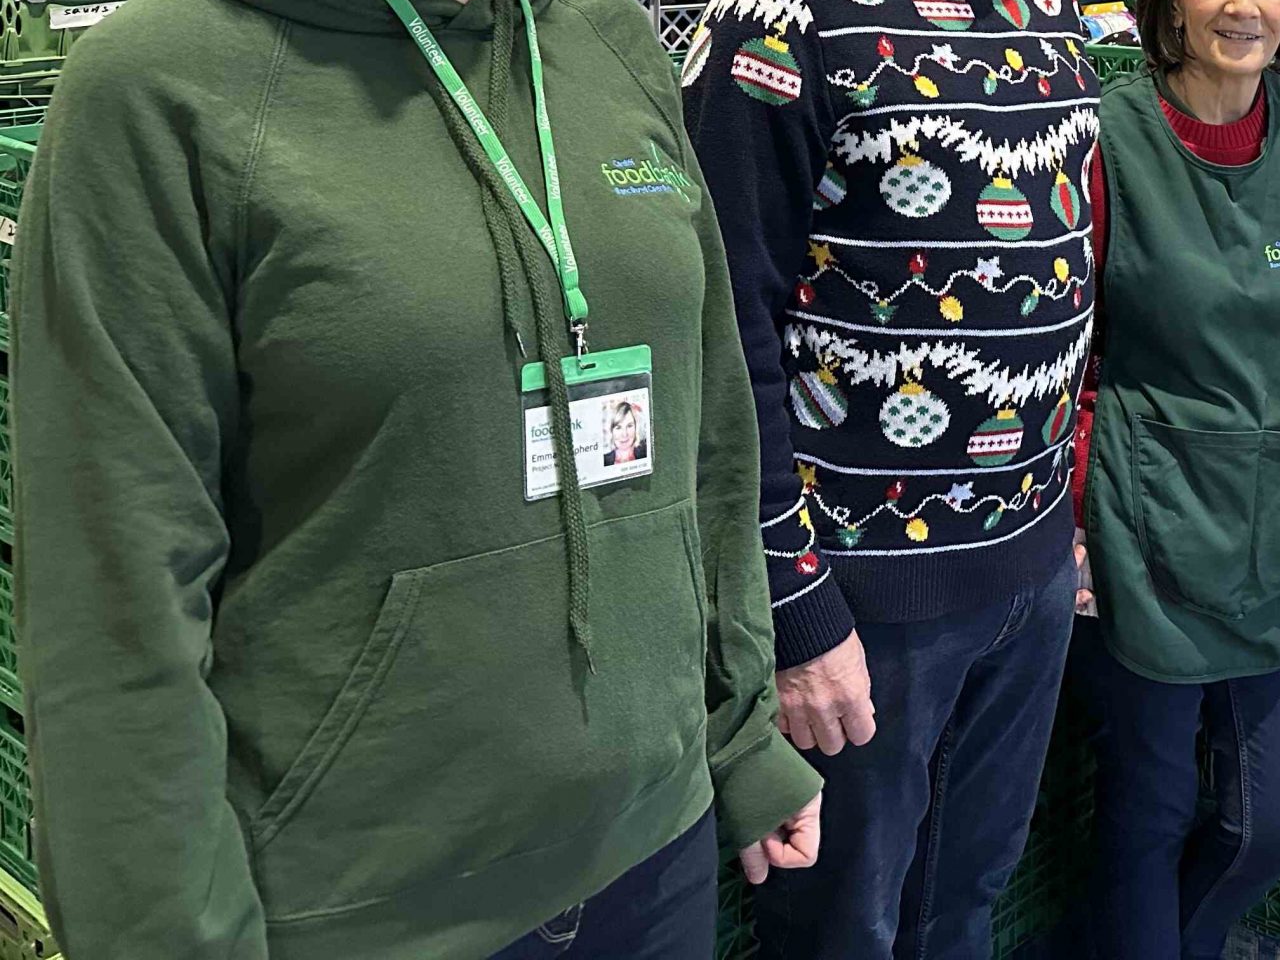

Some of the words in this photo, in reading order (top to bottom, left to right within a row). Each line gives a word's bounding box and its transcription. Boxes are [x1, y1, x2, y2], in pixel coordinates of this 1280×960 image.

[408, 17, 446, 68] Volunteer
[454, 86, 489, 136] Volunteer
[496, 156, 529, 204] Volunteer
[601, 160, 690, 187] foodbank
[559, 223, 577, 273] Volunteer
